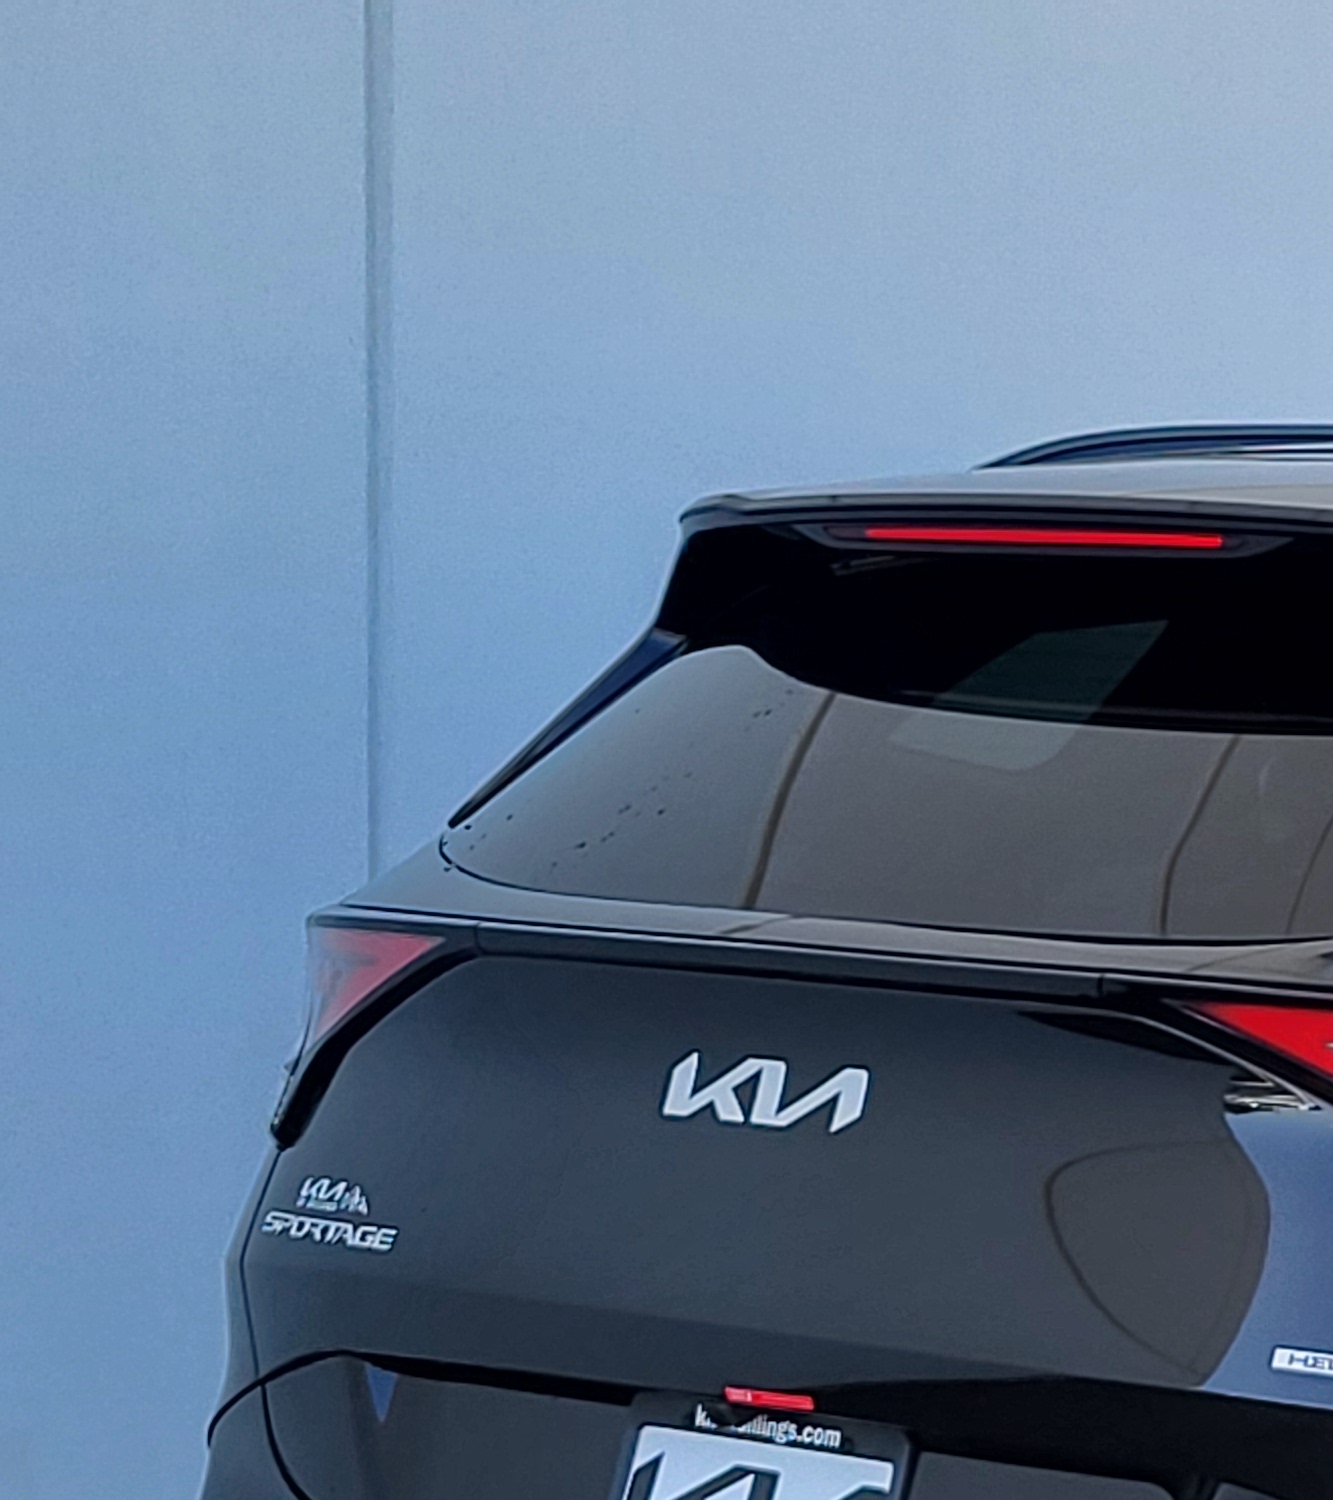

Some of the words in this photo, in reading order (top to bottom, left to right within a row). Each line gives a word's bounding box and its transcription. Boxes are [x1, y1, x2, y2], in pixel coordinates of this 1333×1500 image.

[661, 1050, 870, 1133] KIA
[299, 1176, 348, 1202] KIA
[260, 1210, 399, 1252] SPORTAGE
